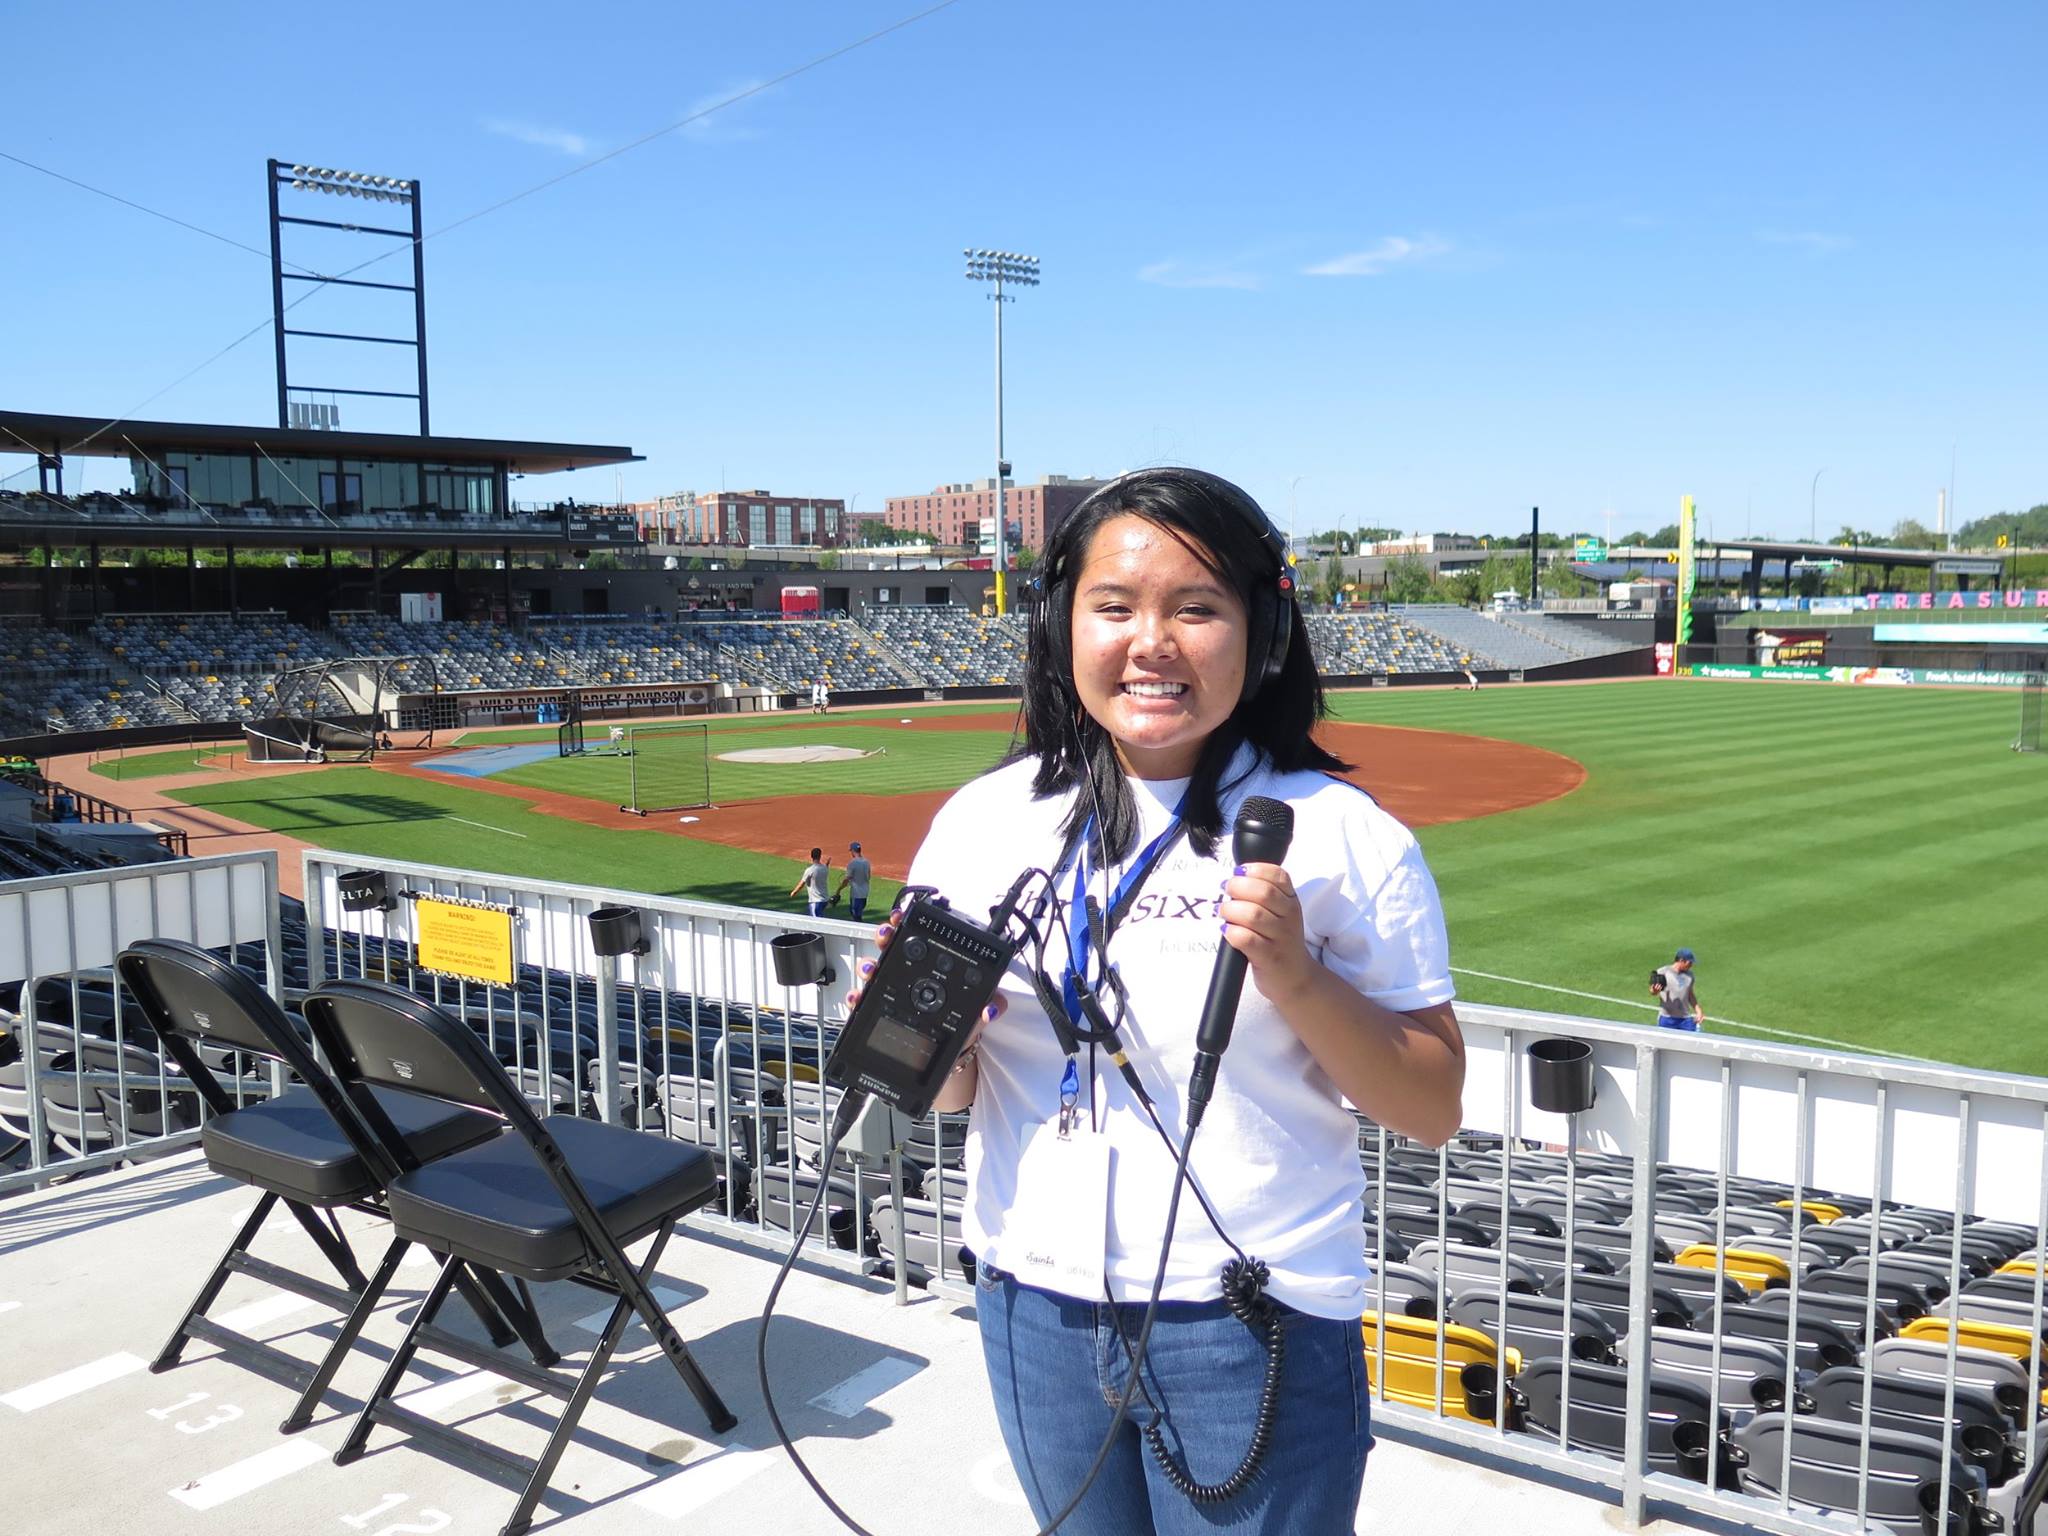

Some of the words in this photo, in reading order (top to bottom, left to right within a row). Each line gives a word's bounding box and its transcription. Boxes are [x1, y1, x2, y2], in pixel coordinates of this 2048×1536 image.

[480, 698, 514, 712] WILD
[518, 693, 568, 711] PRAIRI
[858, 1076, 901, 1100] marantz
[146, 1391, 244, 1434] 13
[338, 1492, 453, 1536] 12
